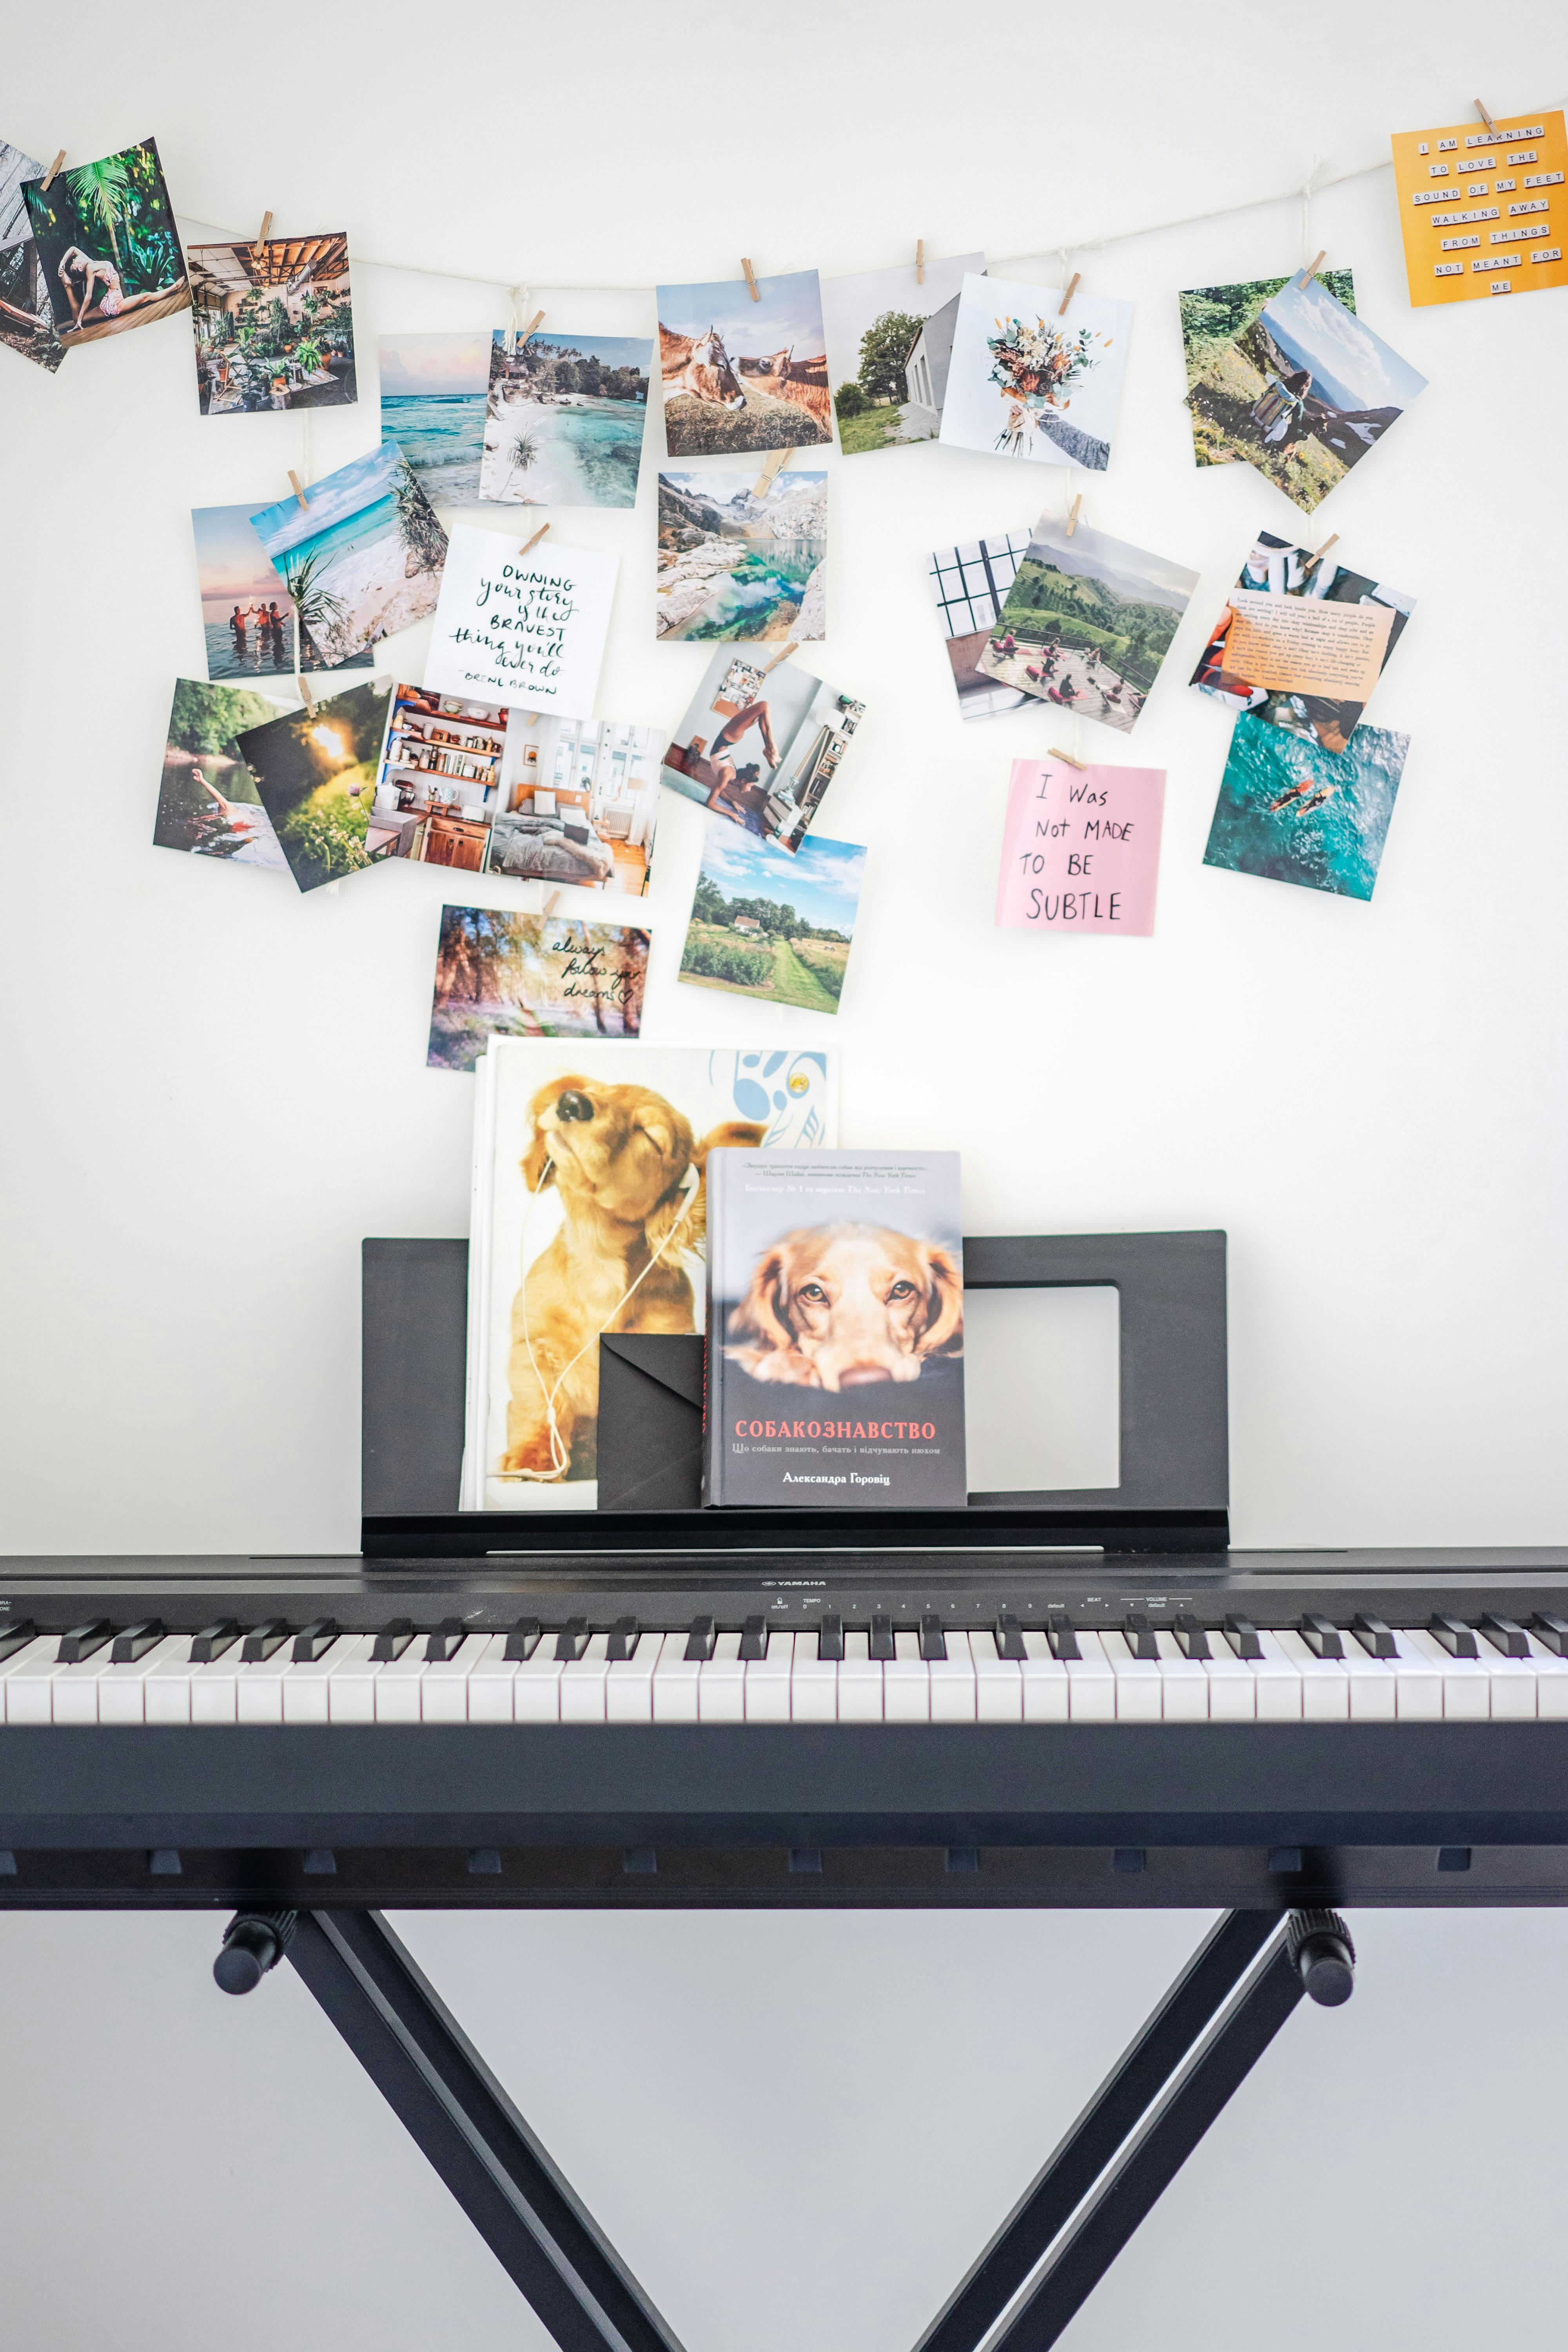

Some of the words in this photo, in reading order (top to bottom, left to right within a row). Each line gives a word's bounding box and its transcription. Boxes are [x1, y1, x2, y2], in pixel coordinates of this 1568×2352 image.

[1459, 159, 1494, 171] LOVE
[1509, 153, 1534, 162] THE
[1415, 191, 1458, 202] SOUND
[1470, 185, 1485, 194] OF
[1497, 181, 1513, 189] MY
[1526, 173, 1561, 185] FEET
[1432, 209, 1498, 223] WALKING
[1511, 201, 1546, 213] AWAY
[1443, 238, 1478, 247] FROM
[1492, 227, 1547, 241] THINGS
[1437, 265, 1460, 273] NOT
[1474, 256, 1519, 269] MEANT
[1533, 250, 1559, 260] FOR
[503, 565, 577, 591] OWNING
[476, 577, 521, 606] your
[529, 589, 579, 621] story
[536, 606, 561, 621] the
[490, 615, 566, 641] BRAVEST
[449, 627, 510, 664] thing
[502, 657, 534, 673] ever
[510, 679, 557, 695] BROWN
[1036, 773, 1053, 799] I
[1069, 784, 1108, 806] Was
[1084, 820, 1135, 841] MADE
[1019, 853, 1045, 875] TO
[1068, 853, 1094, 876] BE
[1026, 888, 1121, 920] SUBTLE
[552, 936, 605, 966] always
[564, 982, 614, 1001] dreams
[735, 1420, 936, 1439] СОБАКОЗНАВСТВО
[732, 1443, 750, 1453] Що
[860, 1446, 909, 1455] відчувають
[782, 1472, 847, 1485] Александра
